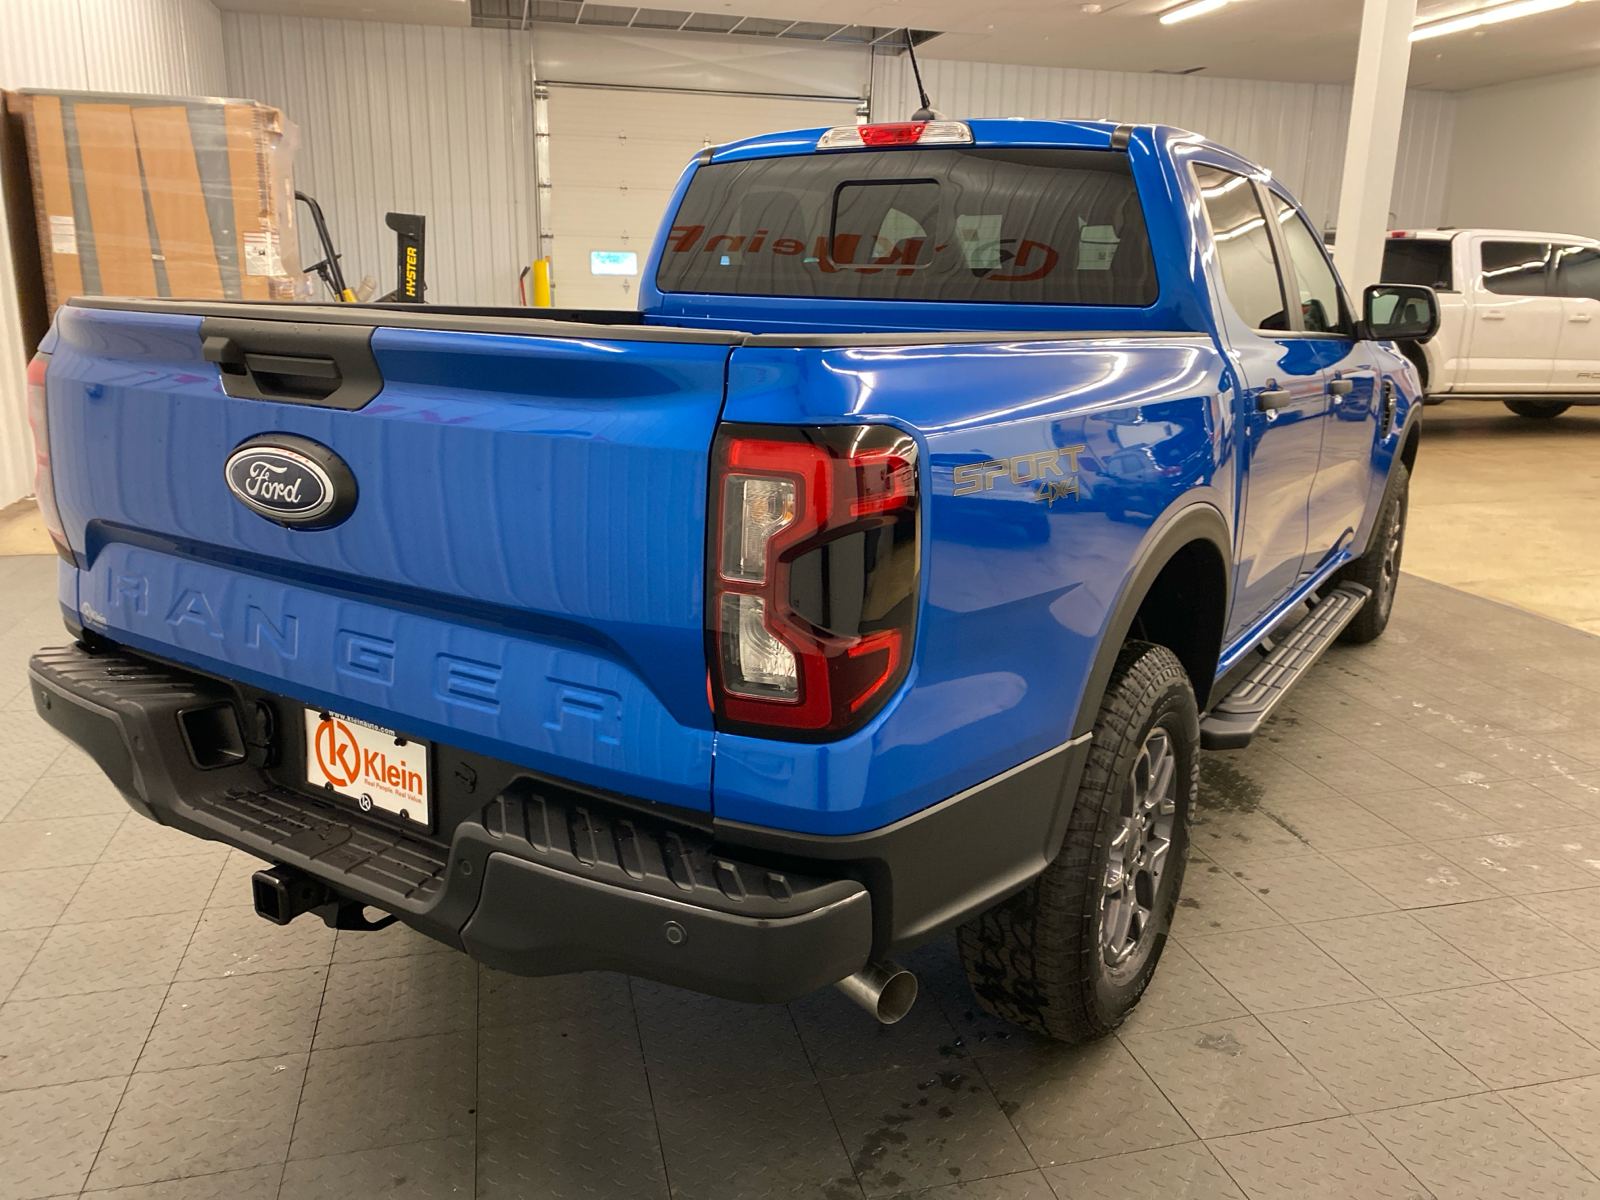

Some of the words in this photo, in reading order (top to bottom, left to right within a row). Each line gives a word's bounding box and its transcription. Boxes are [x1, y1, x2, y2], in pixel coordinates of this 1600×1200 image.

[405, 246, 417, 297] HYSTER
[245, 461, 302, 503] Ford
[953, 444, 1086, 497] SPORT
[107, 566, 622, 745] RANGER
[328, 710, 396, 736] www.kleinauto.com
[363, 748, 423, 795] Klein
[364, 778, 375, 787] Real
[394, 789, 407, 798] Real
